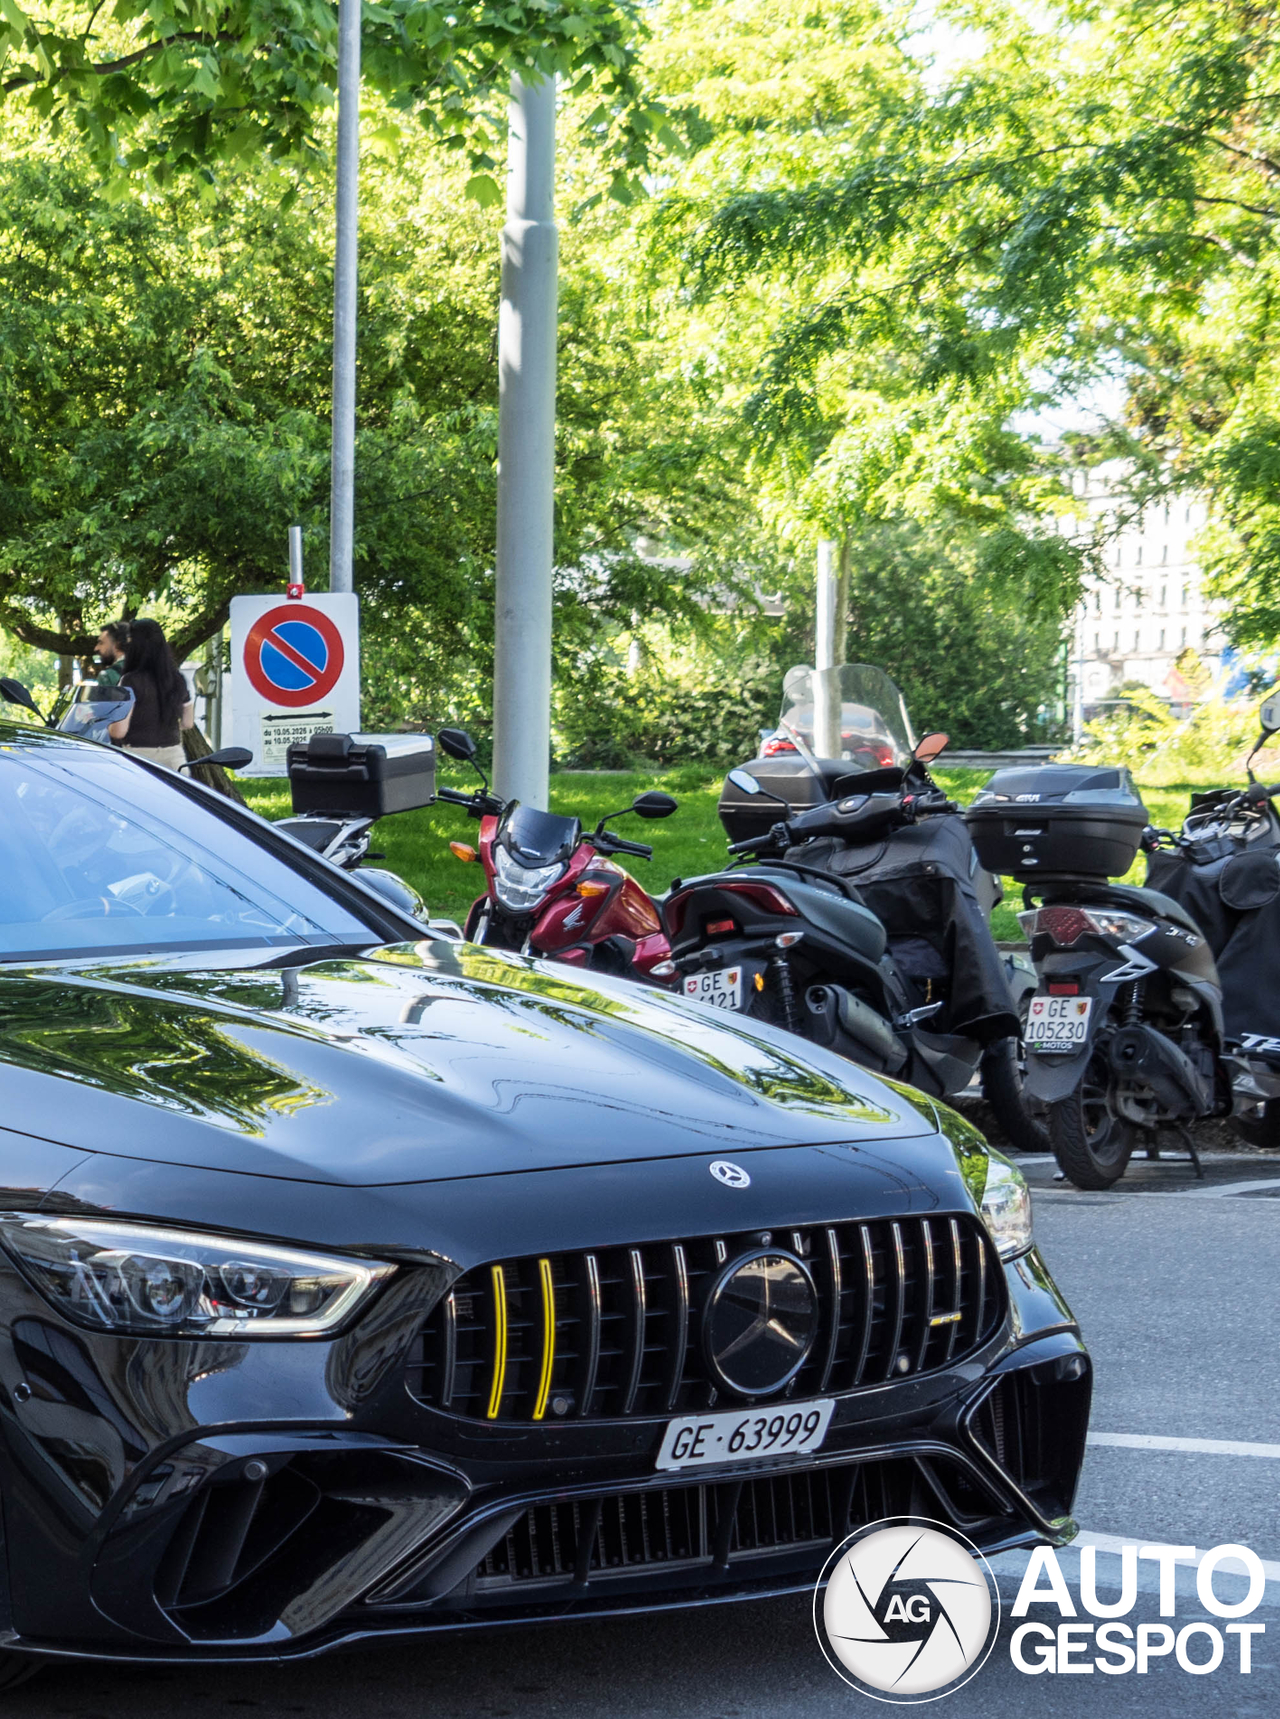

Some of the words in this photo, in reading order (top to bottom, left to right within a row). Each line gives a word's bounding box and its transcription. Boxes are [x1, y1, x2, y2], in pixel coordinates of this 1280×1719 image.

[701, 972, 723, 993] GE
[1048, 1000, 1070, 1017] GE
[1028, 1021, 1085, 1039] 105230
[671, 1423, 715, 1460] GE
[727, 1410, 821, 1453] 63999
